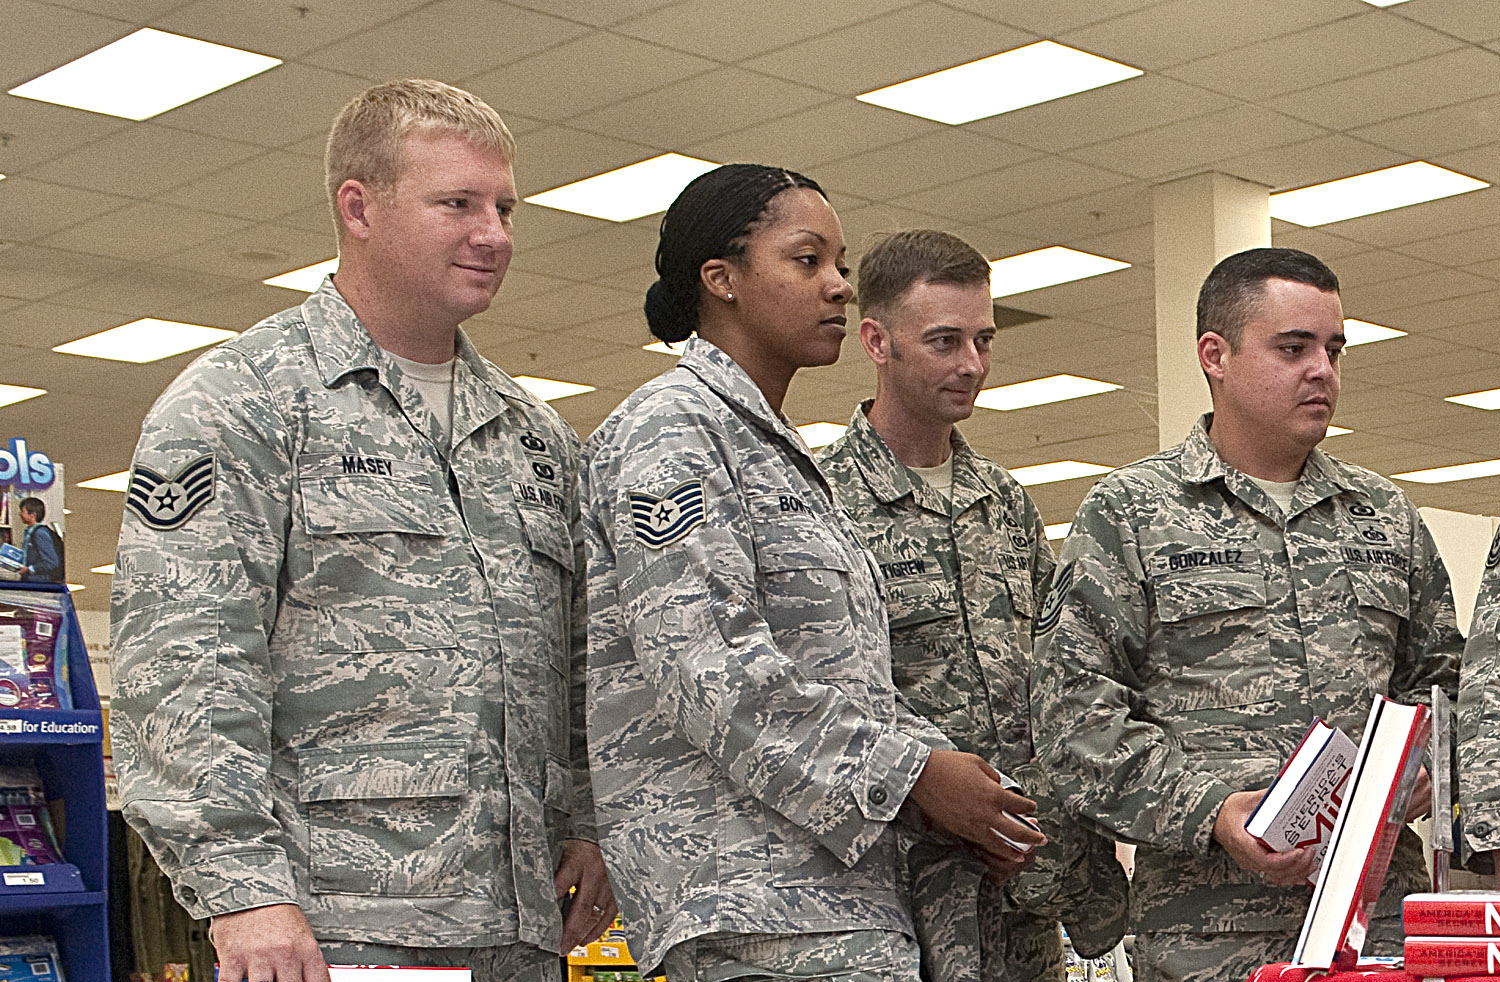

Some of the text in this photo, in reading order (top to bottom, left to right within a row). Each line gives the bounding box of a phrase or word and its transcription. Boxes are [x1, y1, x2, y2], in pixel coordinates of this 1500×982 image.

[342, 456, 393, 476] MASEY
[1169, 551, 1243, 571] GONZALEZ
[1367, 549, 1383, 565] AIR
[879, 559, 926, 579] TIGREW
[22, 720, 39, 733] for
[1284, 753, 1344, 840] AMERICA'S
[1287, 757, 1348, 846] SECRET
